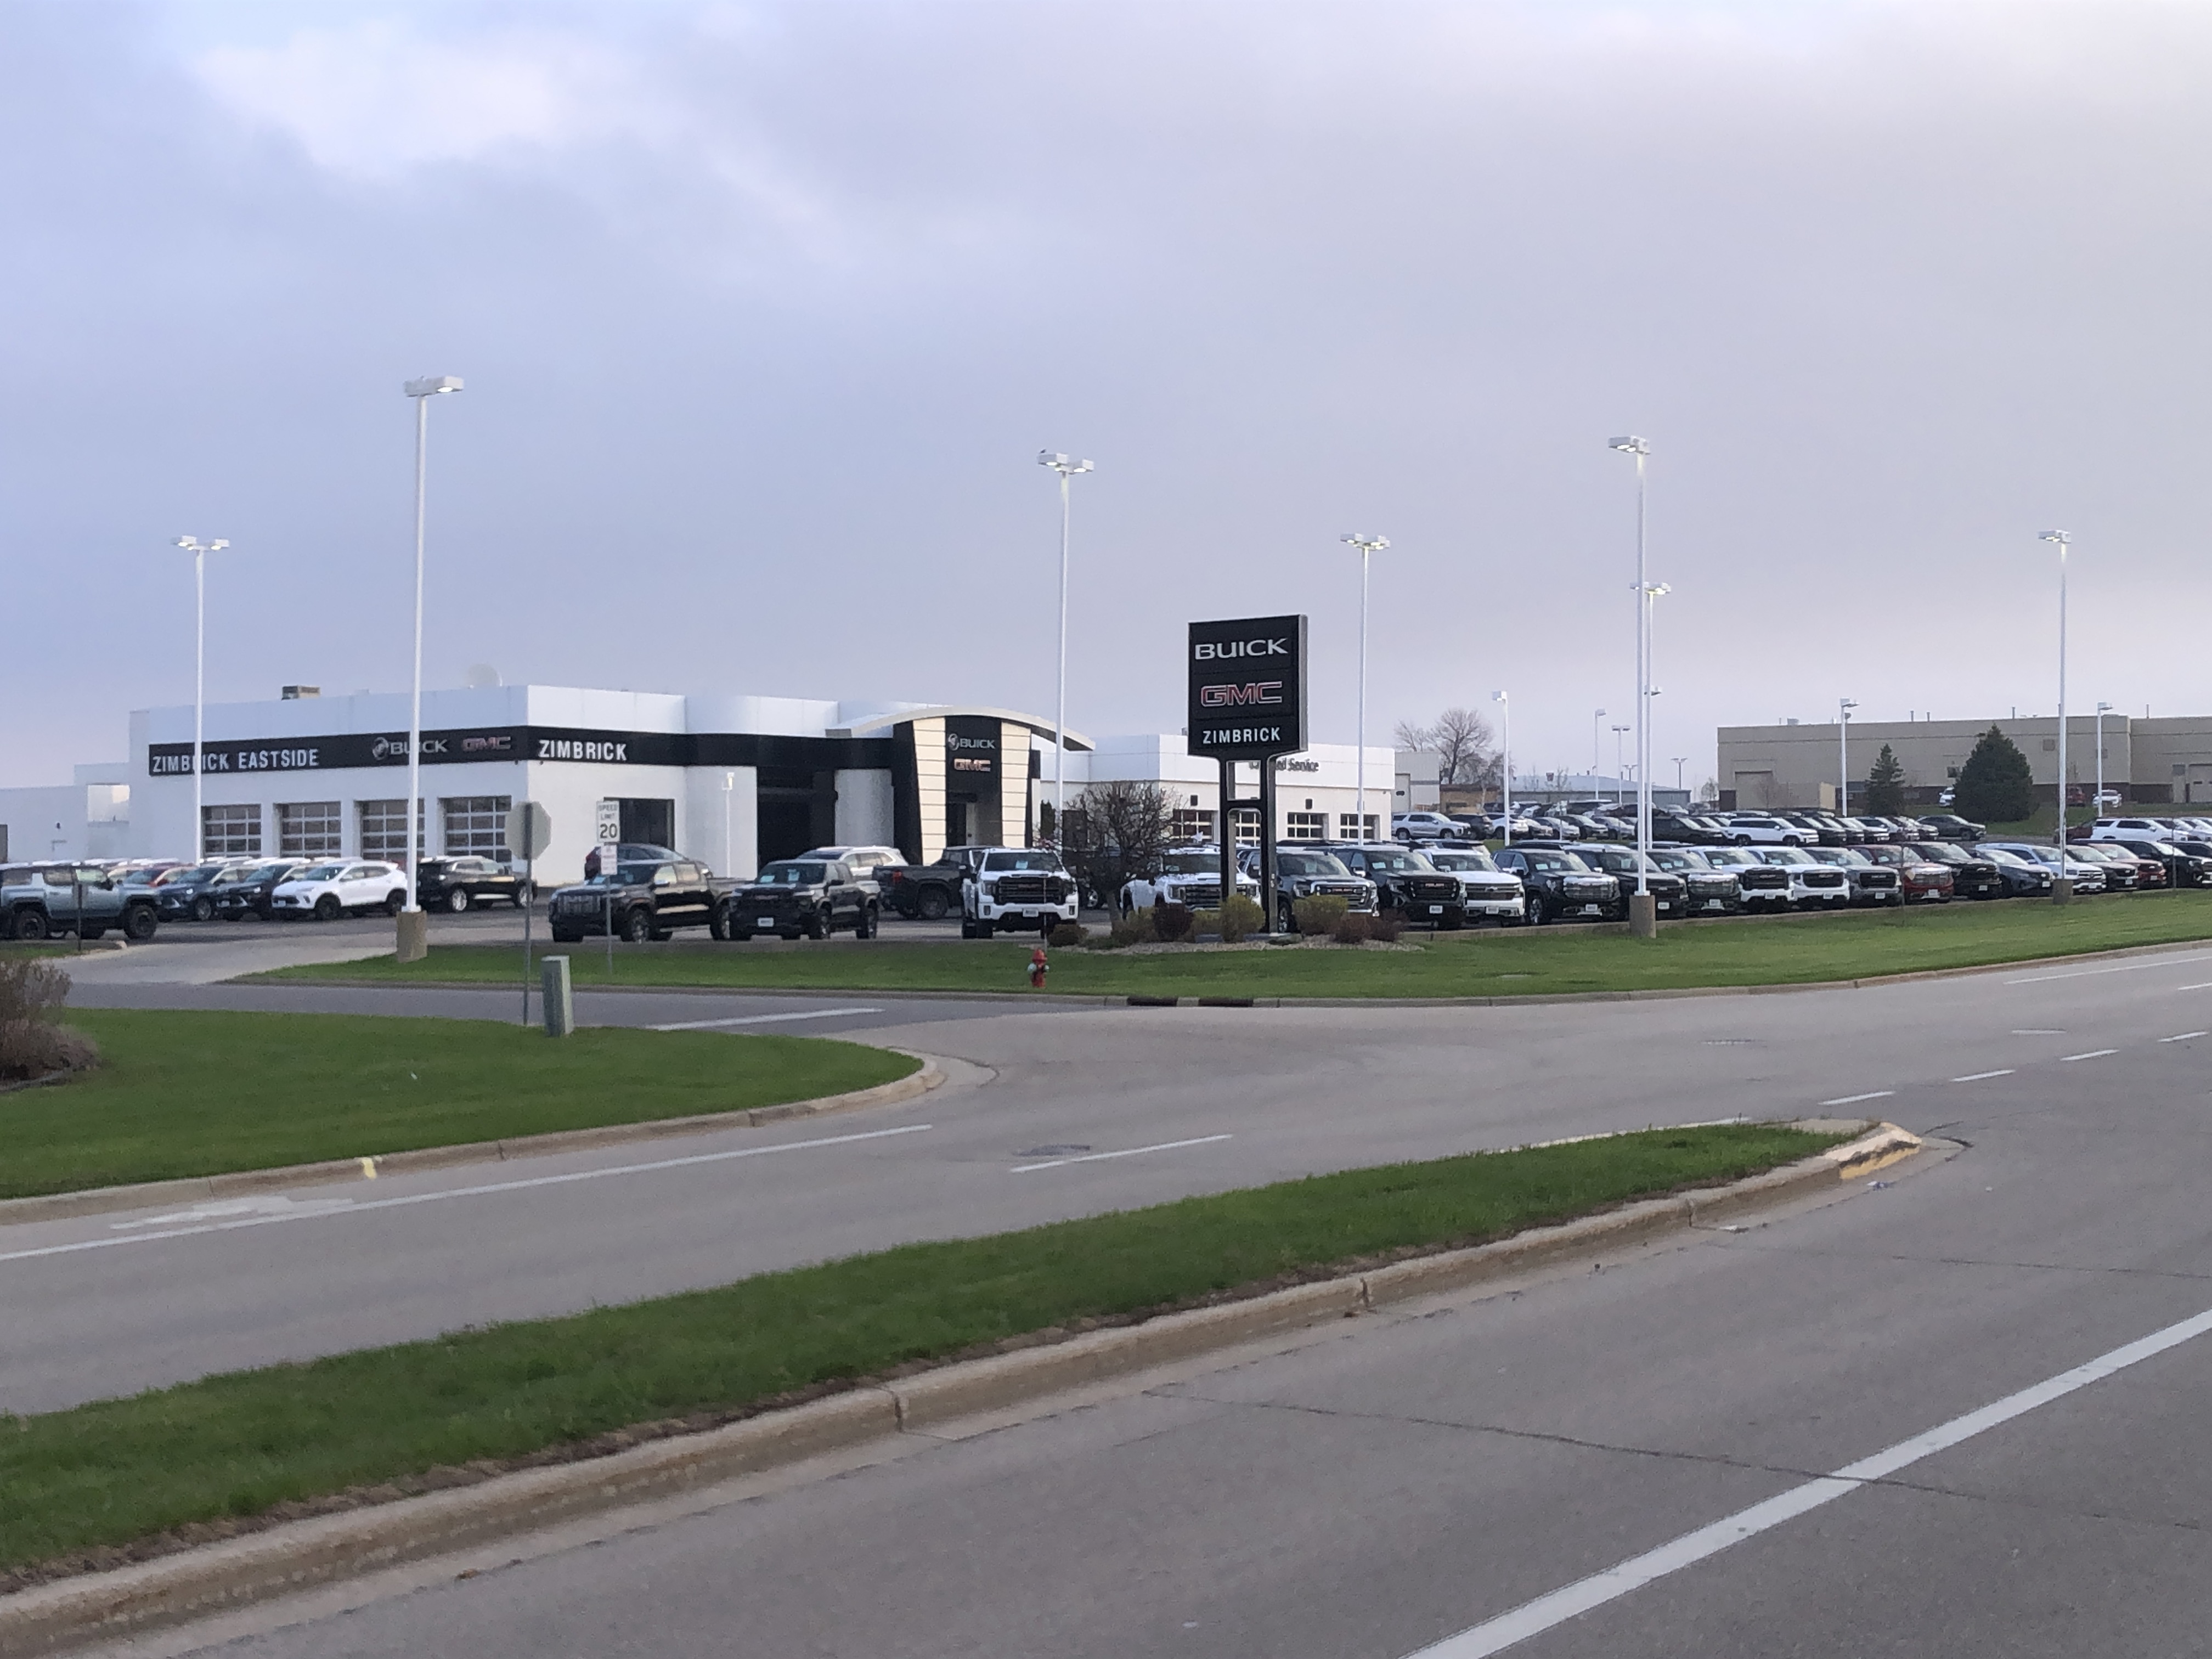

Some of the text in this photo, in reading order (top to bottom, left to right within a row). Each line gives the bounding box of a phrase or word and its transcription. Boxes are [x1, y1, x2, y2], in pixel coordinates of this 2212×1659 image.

[1195, 637, 1289, 660] BUICK
[1201, 680, 1283, 707] GMC
[462, 736, 511, 752] GMC
[960, 738, 996, 749] BUICK
[1203, 727, 1281, 744] ZIMBRICK
[390, 738, 448, 755] BUCK
[538, 739, 627, 761] ZIMBRICK
[153, 748, 319, 772] ZIMBICK EASTSIDE
[954, 758, 991, 772] GMC
[1288, 758, 1319, 772] Service
[600, 823, 618, 839] 20
